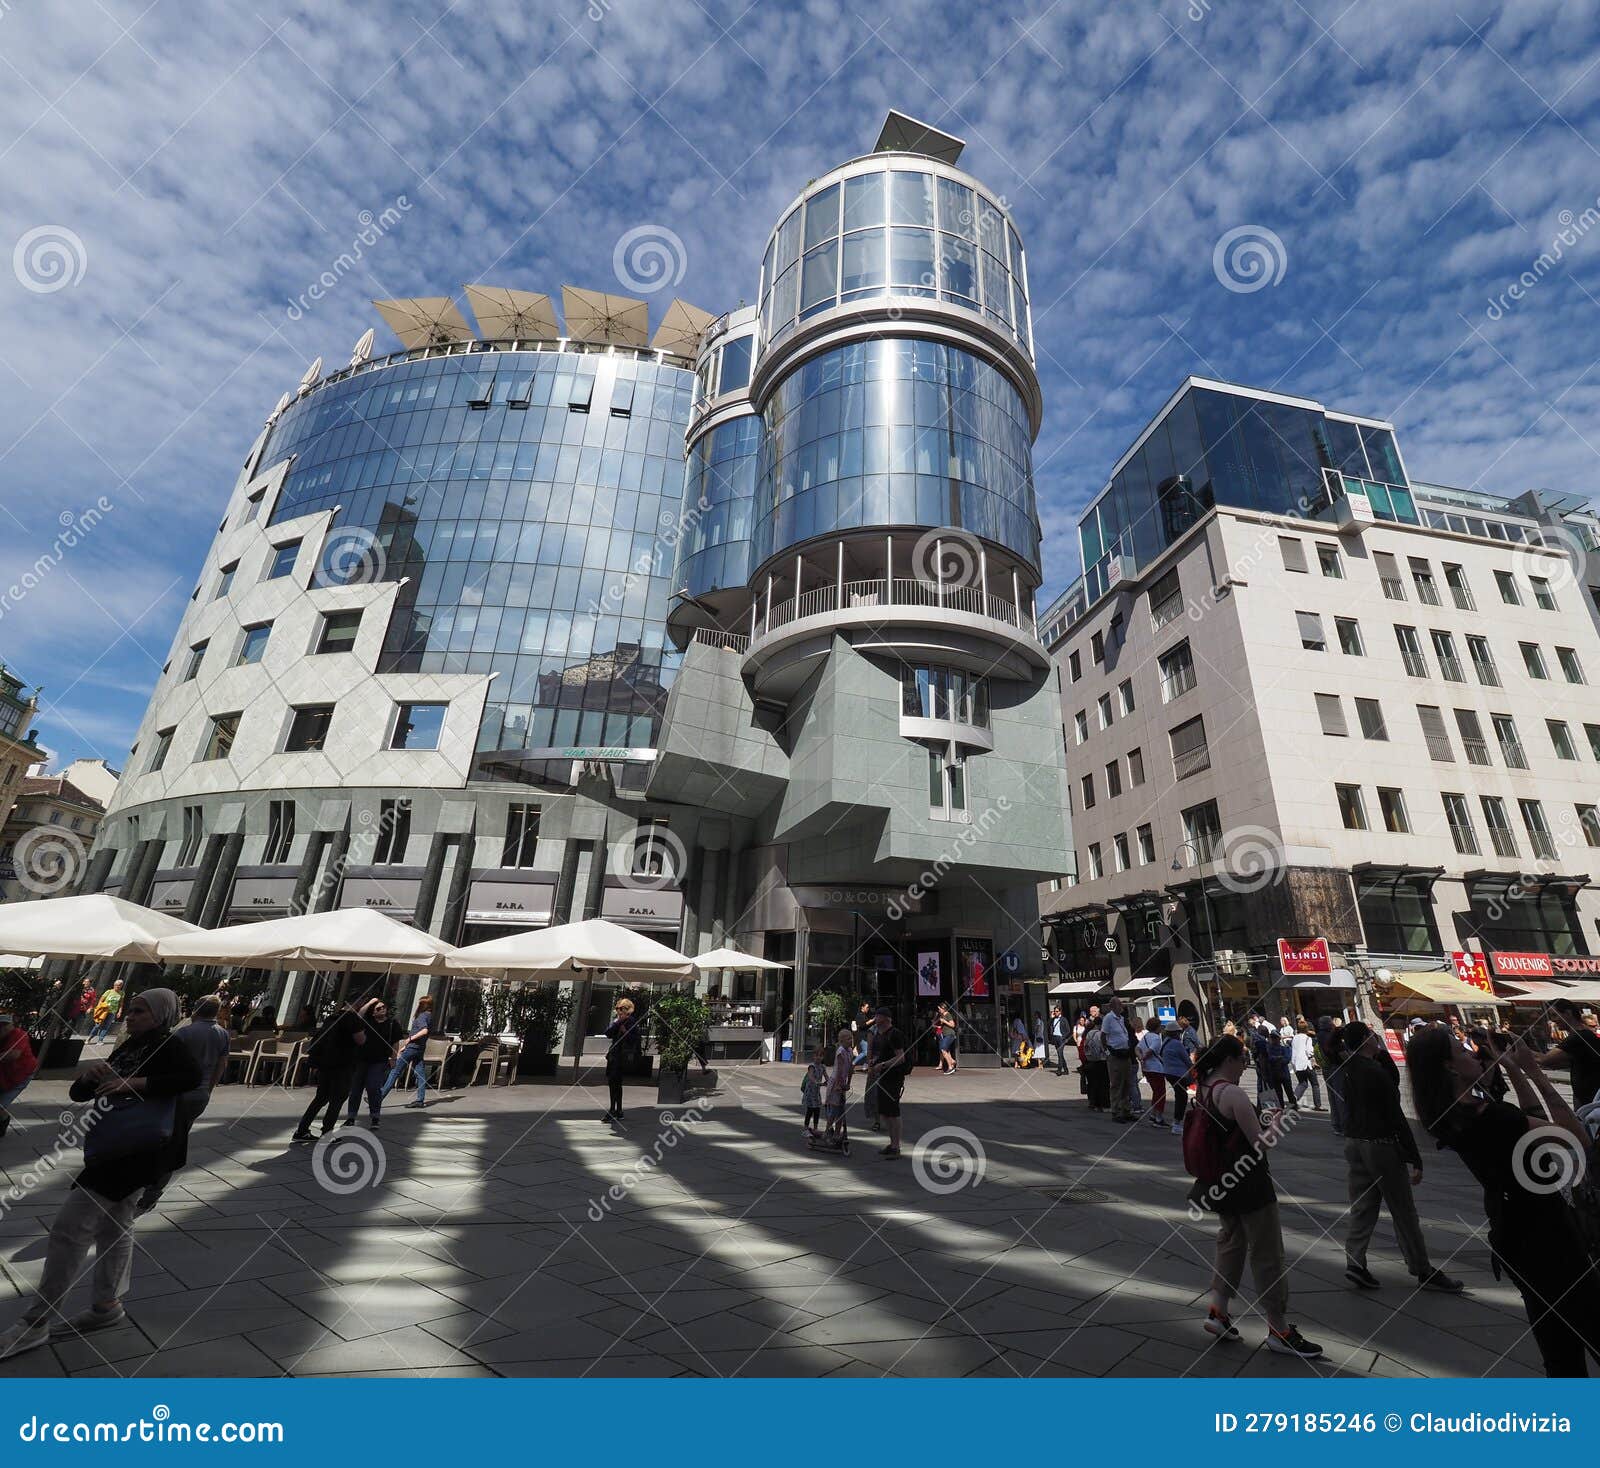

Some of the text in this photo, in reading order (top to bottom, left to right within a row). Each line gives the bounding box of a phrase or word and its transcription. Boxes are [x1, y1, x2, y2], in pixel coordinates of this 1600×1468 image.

[598, 748, 630, 758] HAUS
[365, 898, 393, 906] ZARA
[495, 902, 525, 910] ZARA
[629, 907, 656, 915] ZARA
[1284, 952, 1326, 960] HEINDL
[1497, 957, 1550, 971] SOUVENIRS
[1459, 966, 1486, 979] 4+1
